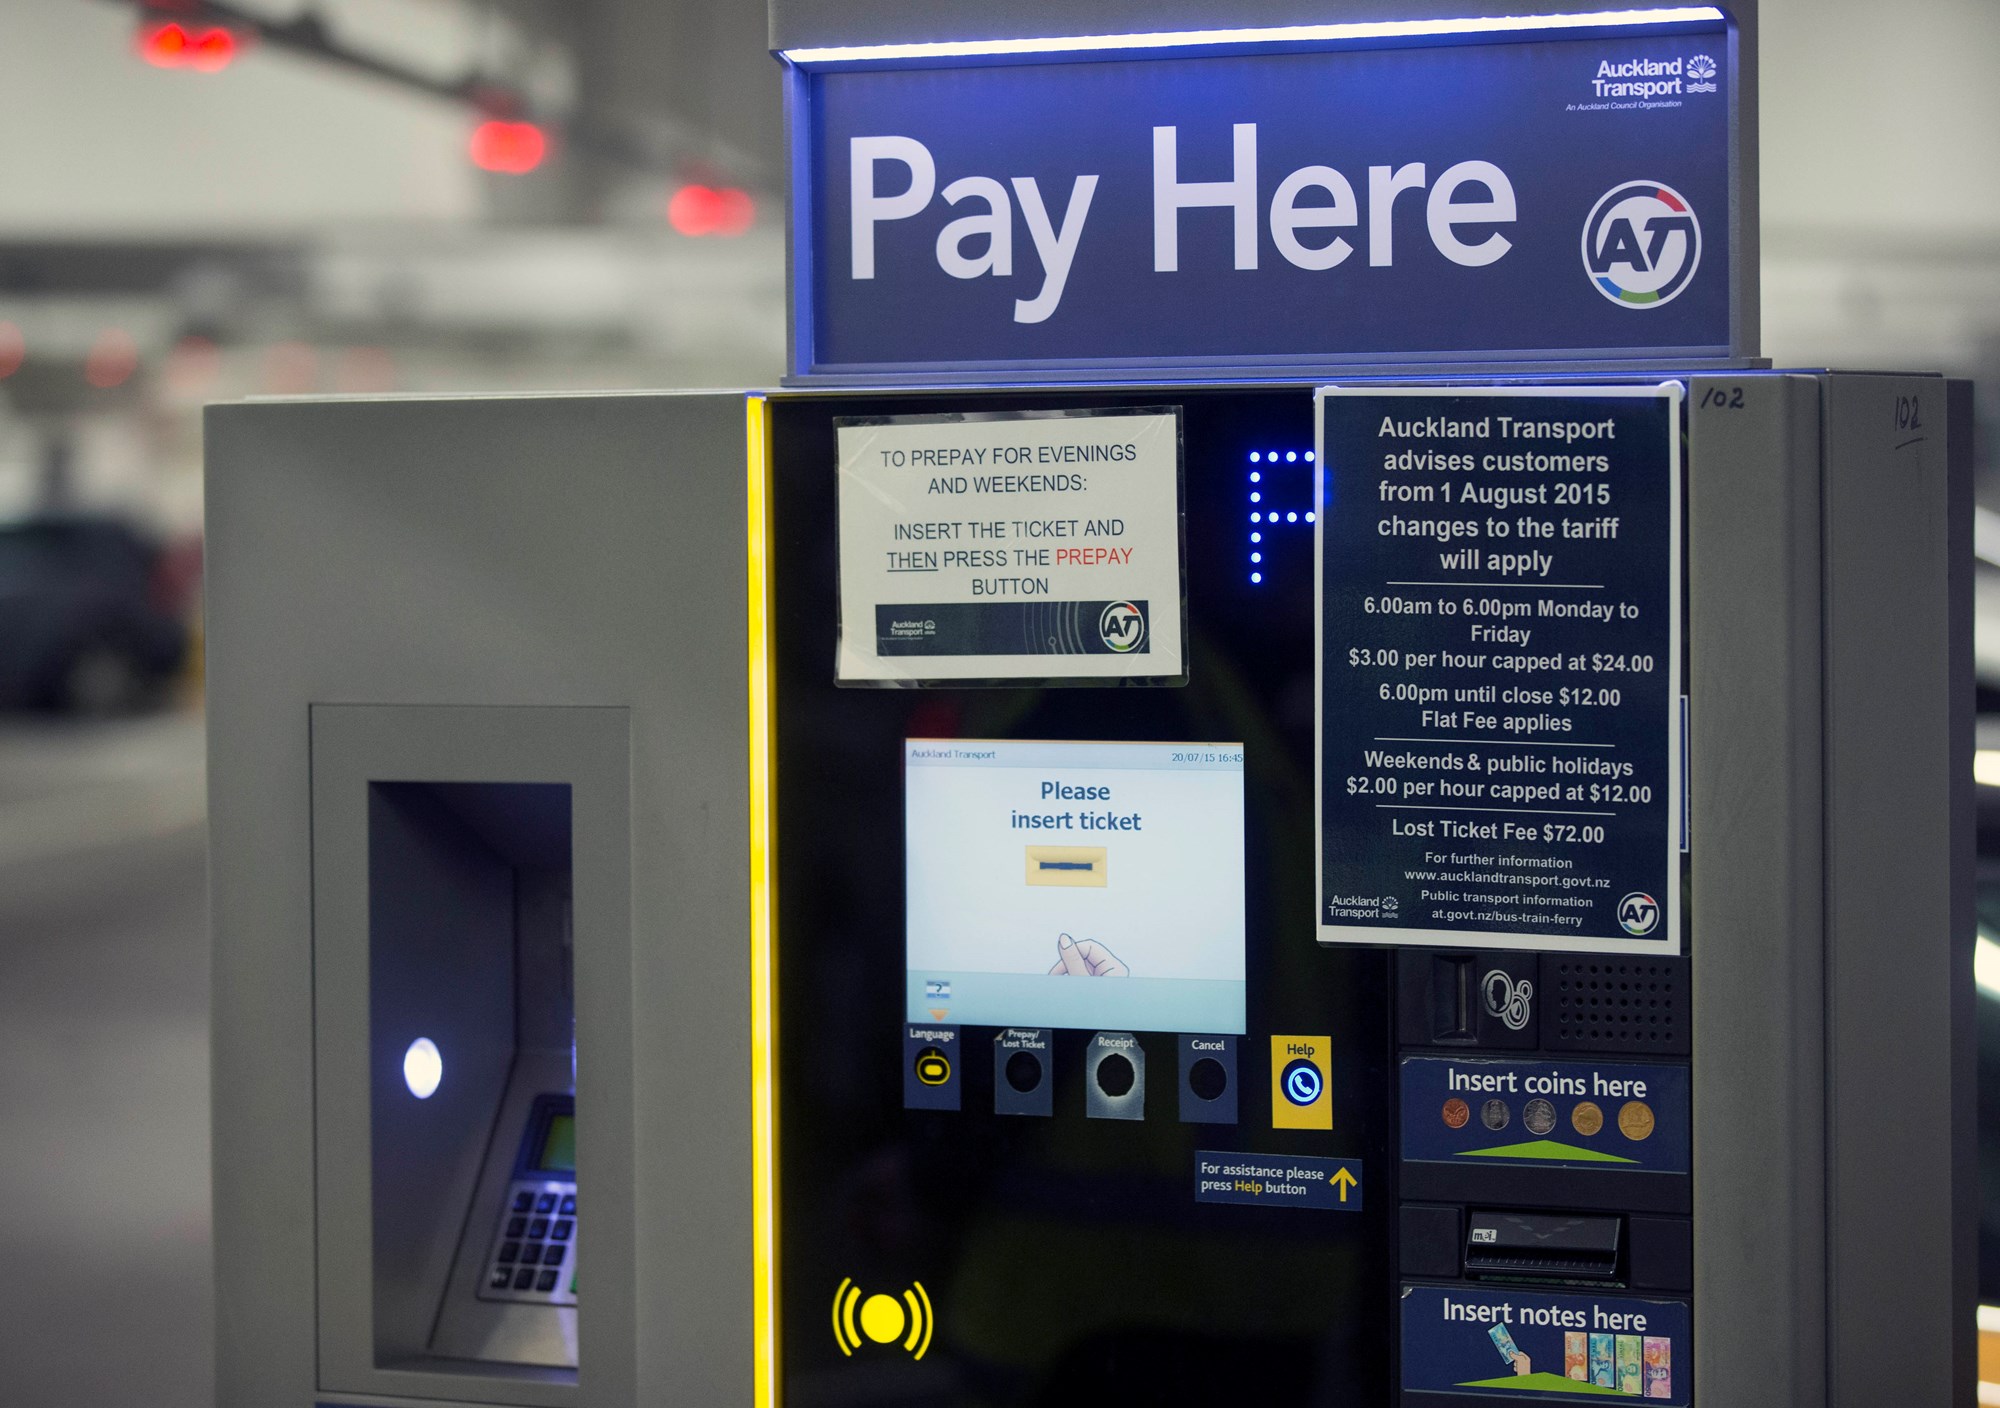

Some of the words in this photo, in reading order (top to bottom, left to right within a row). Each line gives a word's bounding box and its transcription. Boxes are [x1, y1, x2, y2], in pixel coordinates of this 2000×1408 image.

[1596, 57, 1682, 78] Auckland
[1592, 77, 1682, 99] Transport
[1565, 103, 1576, 112] An
[1577, 102, 1610, 111] Auckland
[1611, 101, 1637, 110] Council
[1638, 100, 1682, 110] Organisation
[849, 135, 1099, 324] Pay
[1152, 122, 1518, 274] Here
[1700, 387, 1745, 410] 102
[1895, 395, 1922, 432] 102
[1378, 416, 1490, 438] Auckland
[1497, 416, 1616, 444] Transport
[880, 450, 906, 468] TO
[911, 447, 987, 467] PREPAY
[993, 446, 1033, 465] FOR
[1039, 443, 1137, 463] EVENINGS
[1384, 449, 1475, 471] advises
[1482, 452, 1610, 473] customers
[928, 476, 968, 494] AND
[973, 474, 1088, 493] WEEKENDS:
[1378, 480, 1434, 502] from
[1441, 482, 1451, 502] 1
[1460, 482, 1548, 509] August
[1554, 484, 1611, 505] 2015
[1250, 451, 1316, 584] P
[893, 522, 962, 541] INSERT
[968, 521, 1006, 539] THE
[1011, 519, 1079, 538] TICKET
[1083, 518, 1125, 537] AND
[1377, 515, 1479, 542] changes
[1486, 517, 1510, 538] to
[1517, 517, 1555, 538] the
[1562, 517, 1620, 539] tariff
[887, 551, 938, 570] THEN
[943, 549, 1008, 568] PRESS
[1013, 548, 1050, 567] THE
[1056, 546, 1133, 566] PREPAY
[1440, 549, 1480, 570] will
[1487, 550, 1553, 576] apply
[972, 577, 1049, 596] BUTTON
[1364, 596, 1433, 614] 6.00am
[1438, 598, 1458, 615] to
[1463, 599, 1532, 620] 6.00pm
[1538, 600, 1614, 622] Monday
[1619, 602, 1639, 620] to
[890, 628, 924, 637] Transport
[892, 620, 924, 629] Auckland
[1471, 625, 1531, 648] Friday
[1349, 648, 1399, 667] $3.00
[1405, 652, 1437, 671] per
[1442, 650, 1487, 669] hour
[1491, 653, 1563, 673] capped
[1568, 655, 1587, 671] at
[1592, 654, 1654, 674] $24.00
[1379, 683, 1448, 703] 6.00pm
[1454, 685, 1497, 703] until
[1502, 686, 1554, 705] close
[1559, 687, 1621, 707] $12.00
[1421, 710, 1458, 729] Flat
[1463, 712, 1497, 730] Fee
[1503, 713, 1573, 734] applies
[911, 749, 952, 759] Auckland
[954, 749, 996, 761] Transport
[1172, 752, 1216, 763] 20/07/15
[1218, 753, 1243, 763] 16:45
[1364, 750, 1464, 770] Weekends
[1467, 753, 1482, 771] &
[1487, 754, 1547, 774] public
[1552, 756, 1634, 780] holidays
[1041, 781, 1111, 801] Please
[1346, 776, 1398, 796] $2.00
[1403, 780, 1435, 800] per
[1440, 778, 1485, 797] hour
[1490, 781, 1561, 802] capped
[1566, 784, 1585, 801] at
[1589, 784, 1652, 804] $12.00
[1011, 810, 1073, 829] insert
[1079, 811, 1142, 831] ticket
[1392, 819, 1435, 837] Lost
[1440, 820, 1498, 840] Ticket
[1503, 823, 1538, 841] Fee
[1543, 824, 1605, 844] $72.00
[1425, 852, 1448, 864] For
[1450, 853, 1495, 866] further
[1498, 855, 1573, 869] information
[1404, 870, 1611, 889] www.aucklandtransport.govt.nz
[1331, 895, 1380, 907] Auckland
[1421, 889, 1460, 902] Public
[1463, 891, 1519, 906] transport
[1522, 894, 1593, 908] information
[1328, 906, 1380, 919] Transport
[1432, 909, 1583, 927] at.govt.nz/bus-train-ferry
[909, 1028, 955, 1042] Language
[1002, 1039, 1020, 1048] Lost
[1022, 1040, 1046, 1049] Ticket
[1008, 1029, 1040, 1041] Prepay/
[1098, 1036, 1134, 1050] Receipt
[1191, 1039, 1225, 1051] Cancel
[1287, 1044, 1315, 1058] Help
[1448, 1067, 1518, 1093] Insert
[1525, 1071, 1586, 1096] coins
[1594, 1072, 1647, 1098] here
[1201, 1162, 1219, 1174] For
[1223, 1164, 1284, 1178] assistance
[1286, 1167, 1325, 1181] please
[1201, 1180, 1232, 1192] press
[1234, 1180, 1263, 1196] Help
[1265, 1181, 1306, 1195] button
[1443, 1298, 1513, 1324] Insert
[1520, 1305, 1587, 1329] notes
[1594, 1305, 1647, 1331] here
